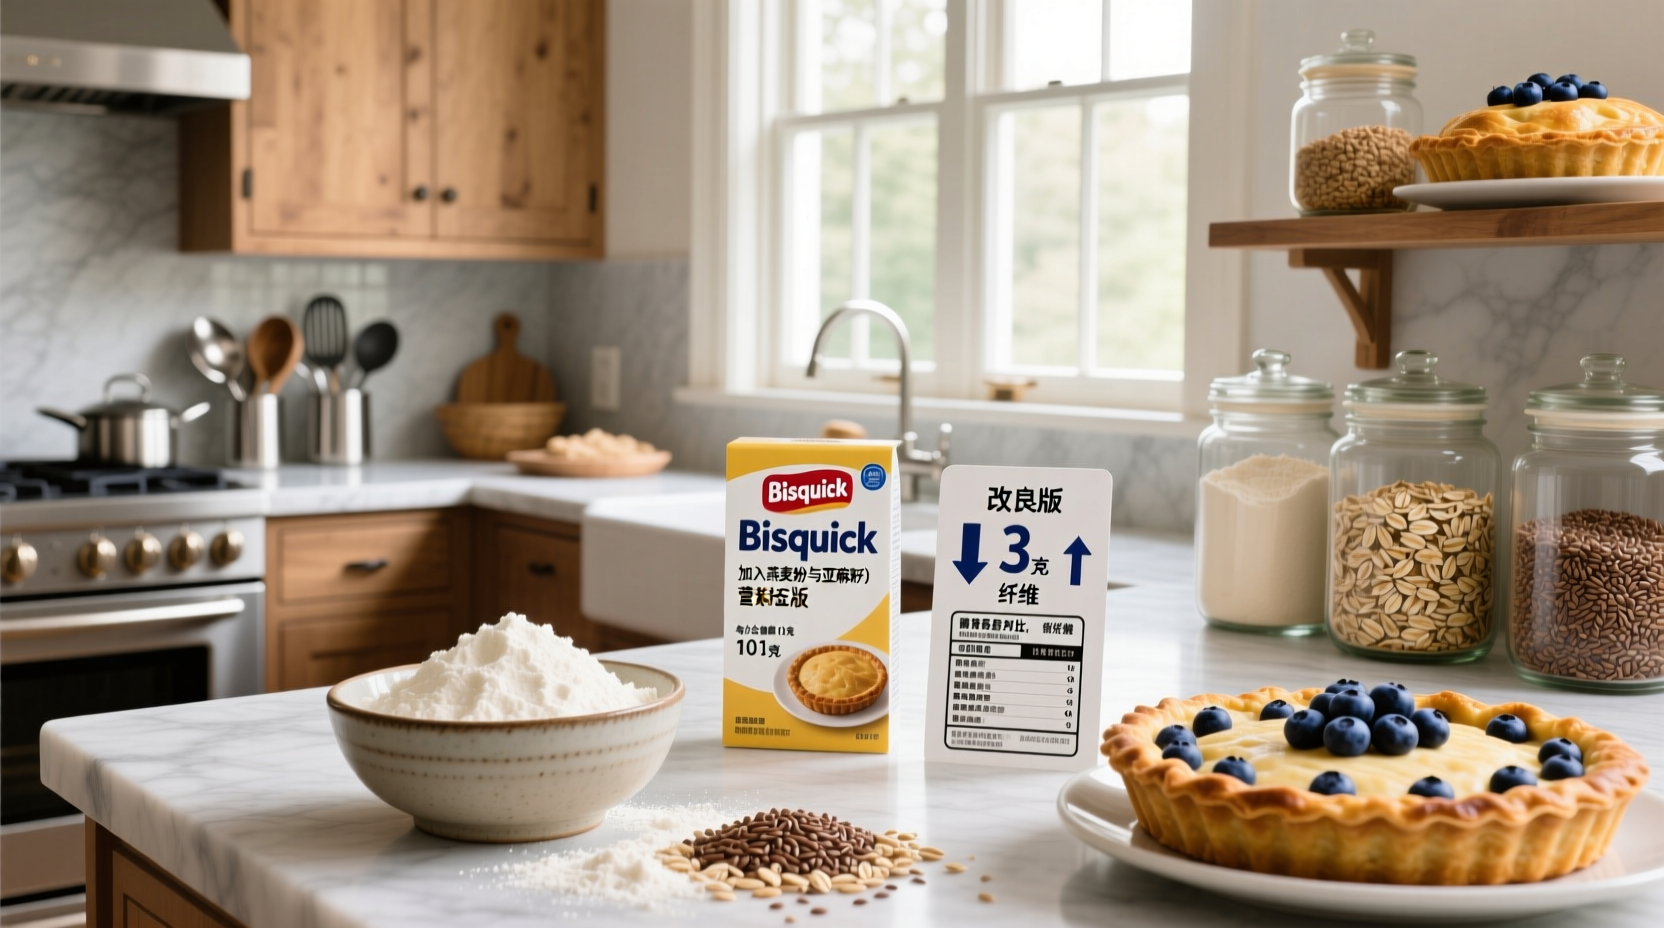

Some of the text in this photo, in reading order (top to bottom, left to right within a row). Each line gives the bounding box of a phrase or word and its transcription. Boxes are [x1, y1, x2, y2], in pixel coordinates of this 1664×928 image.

[768, 478, 848, 505] Bisquick
[987, 486, 1063, 513] 改良版
[739, 519, 878, 561] Bisquick
[998, 582, 1039, 606] 纤维
